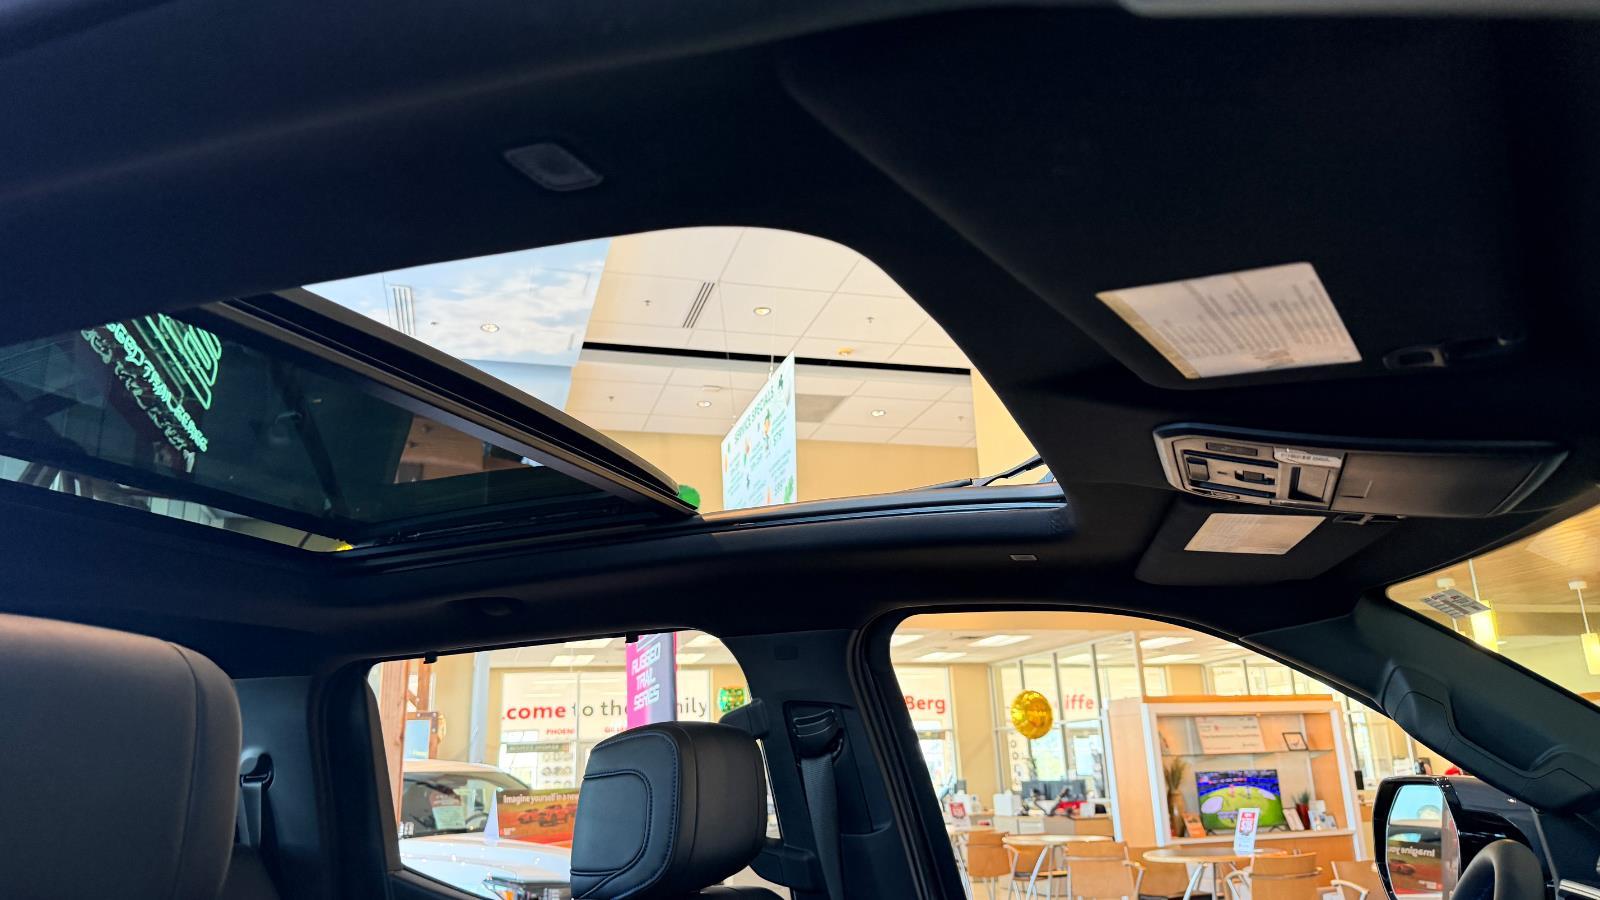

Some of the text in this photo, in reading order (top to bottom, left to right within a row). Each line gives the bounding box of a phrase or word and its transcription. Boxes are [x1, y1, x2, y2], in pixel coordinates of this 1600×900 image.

[633, 683, 660, 711] SERIES
[1064, 694, 1094, 710] iffe
[502, 705, 567, 720] come
[571, 702, 594, 717] to
[503, 793, 530, 805] Imagine
[530, 792, 558, 805] yourself
